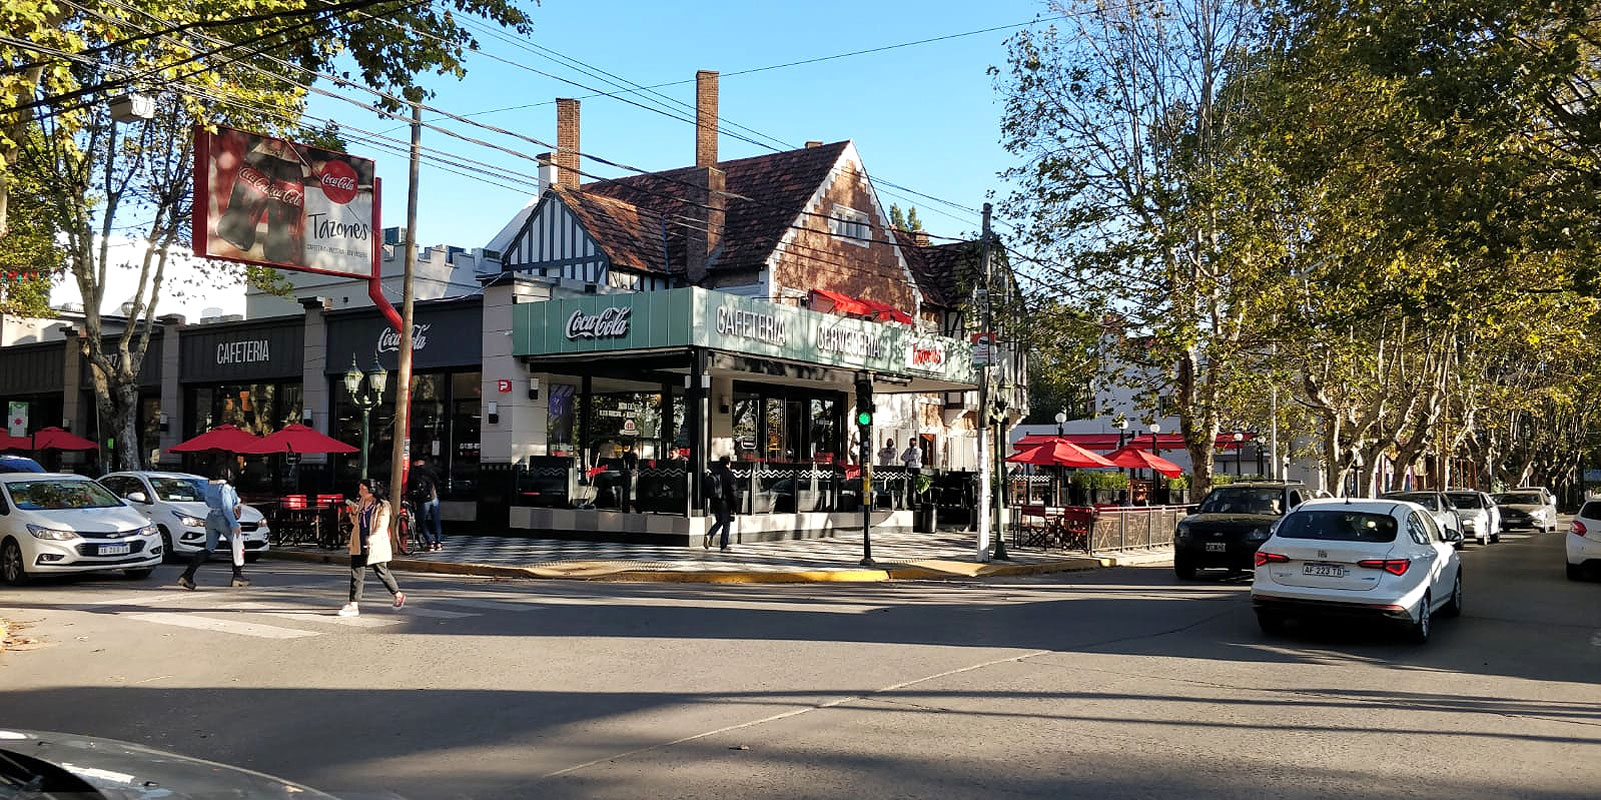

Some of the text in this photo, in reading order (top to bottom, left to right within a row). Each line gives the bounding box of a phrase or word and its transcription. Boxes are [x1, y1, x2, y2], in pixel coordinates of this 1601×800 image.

[308, 212, 369, 240] Tazones
[717, 305, 785, 343] CAFETERIA
[217, 340, 269, 364] CAFETERIA
[817, 325, 880, 358] CERVECERIA
